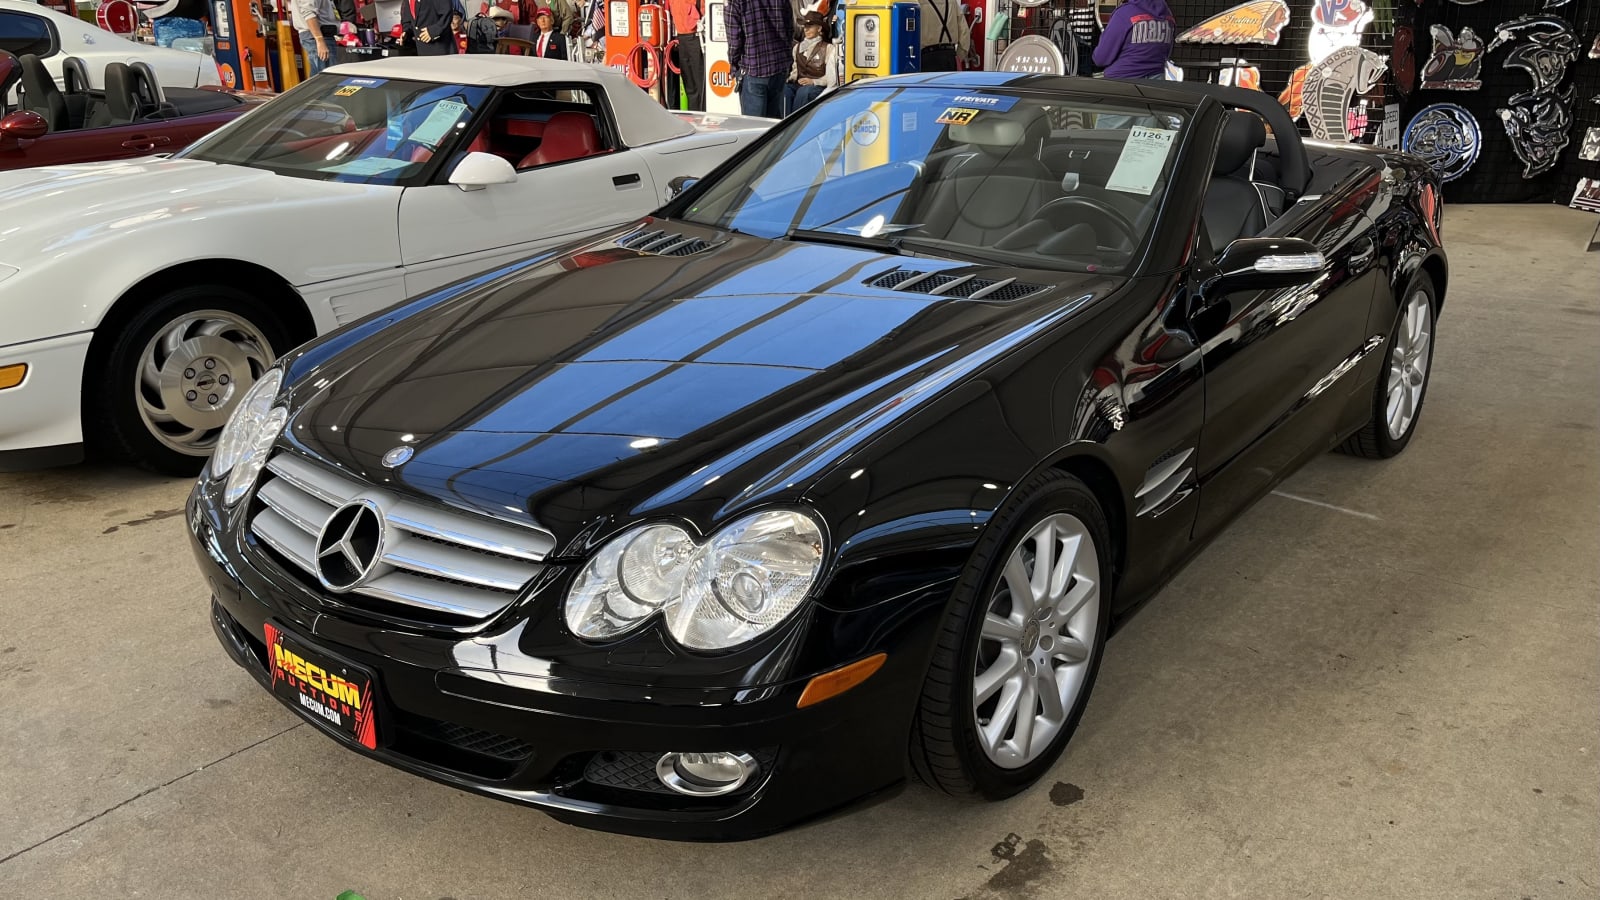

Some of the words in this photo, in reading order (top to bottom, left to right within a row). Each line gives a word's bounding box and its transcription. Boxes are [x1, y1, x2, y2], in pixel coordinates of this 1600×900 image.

[1220, 14, 1258, 25] Indian
[711, 72, 732, 87] GULF
[941, 111, 971, 121] NR
[1385, 110, 1398, 123] SPEED
[853, 125, 877, 133] SUNOCO
[1132, 130, 1171, 141] U126.1
[1384, 127, 1397, 141] LIMIT
[273, 643, 361, 710] MECUM
[277, 668, 362, 723] AUCTIONS
[299, 692, 341, 726] MECUM.COM
